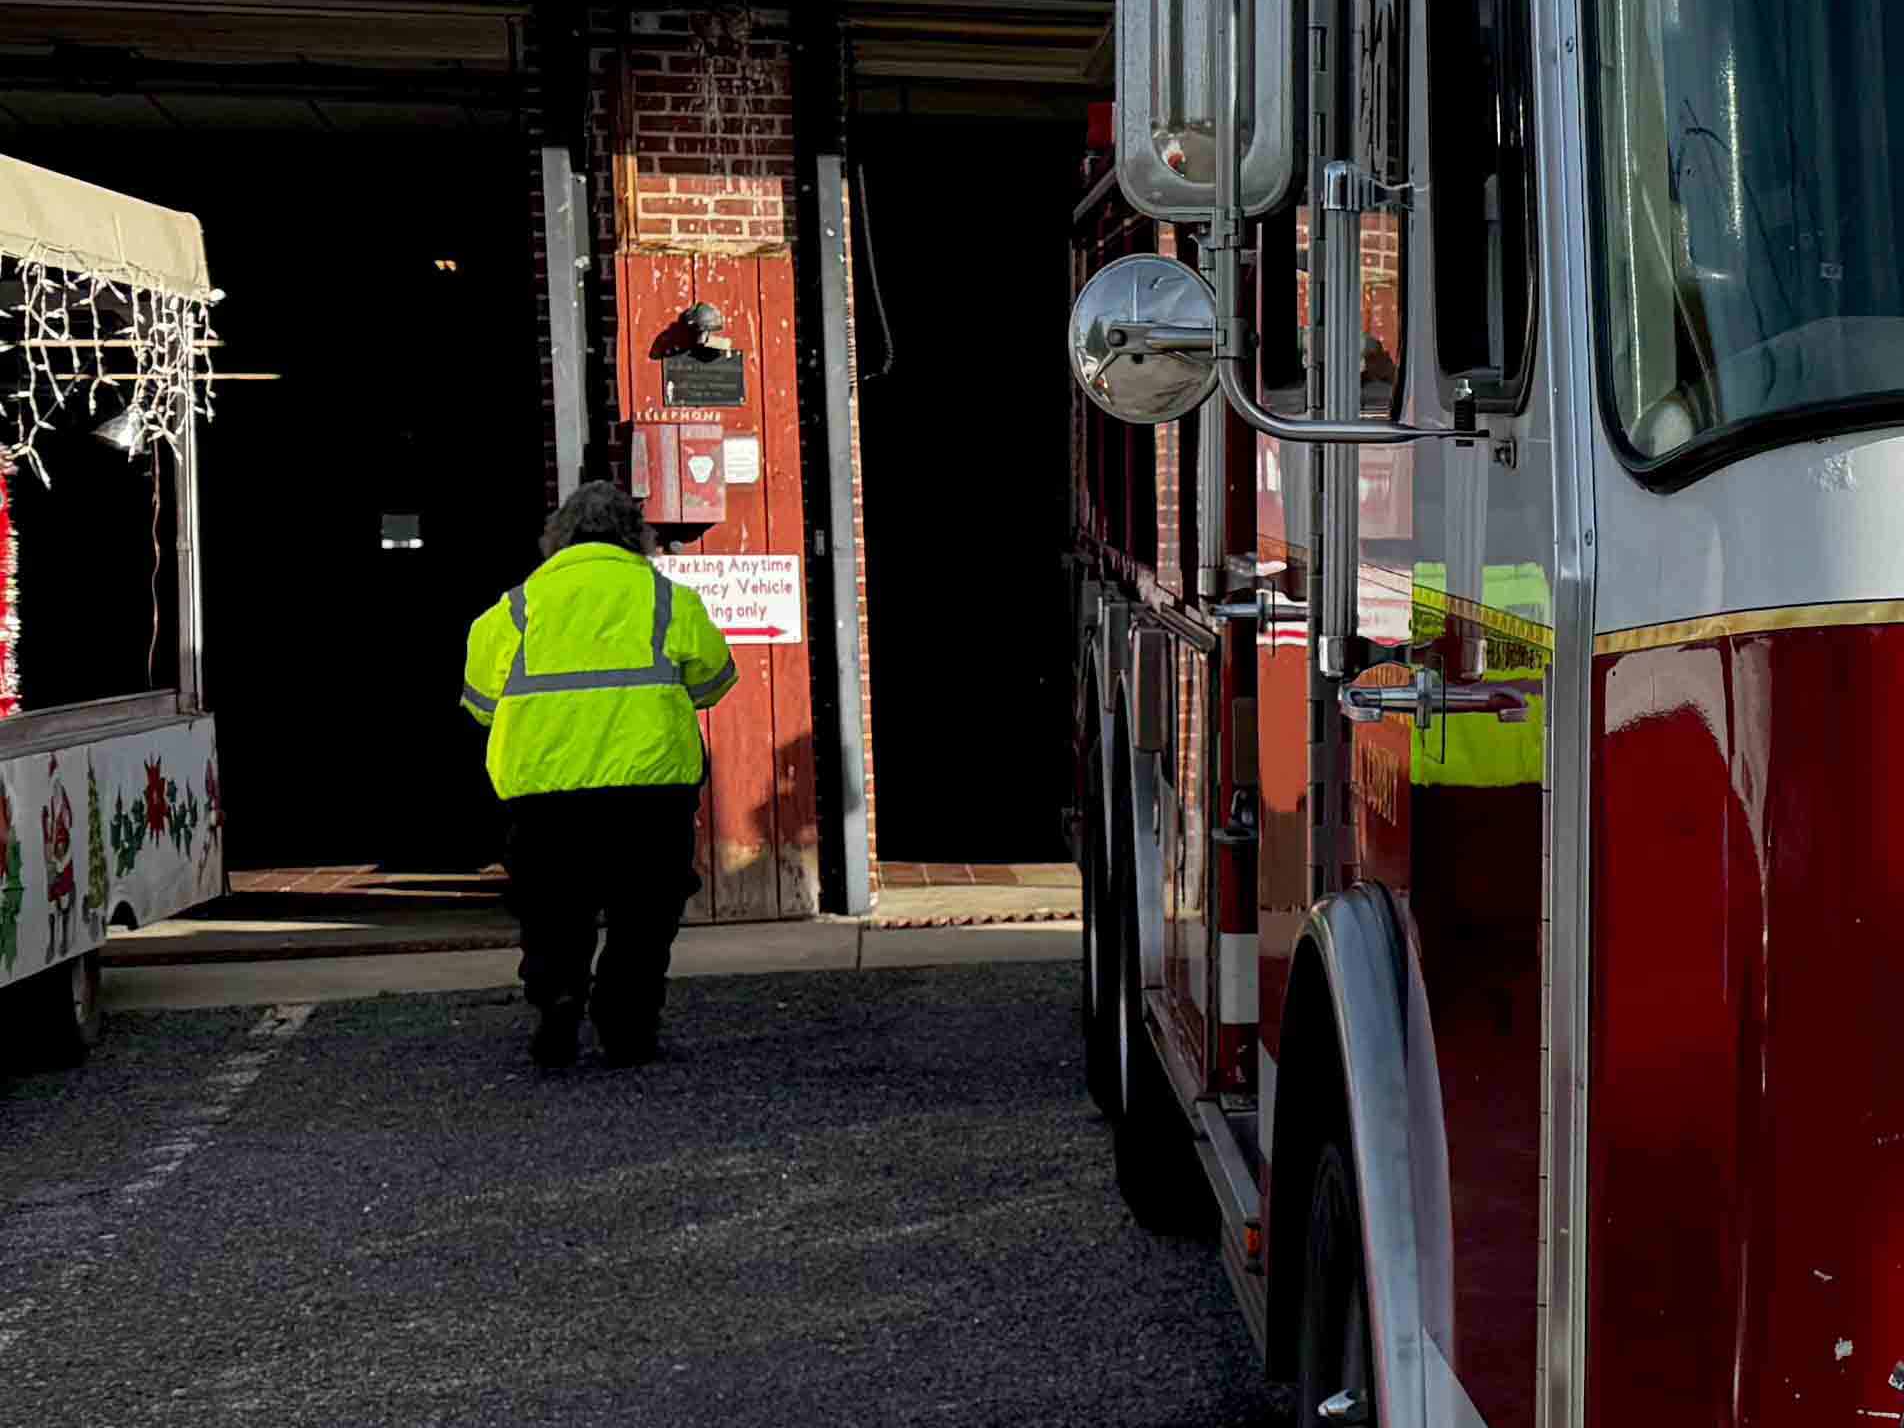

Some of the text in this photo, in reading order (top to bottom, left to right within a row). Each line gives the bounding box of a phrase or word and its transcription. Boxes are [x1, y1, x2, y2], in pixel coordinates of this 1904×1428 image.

[668, 557, 724, 577] Parking
[728, 557, 793, 576] Anytime
[736, 578, 793, 595] Vehicle
[736, 602, 768, 621] only
